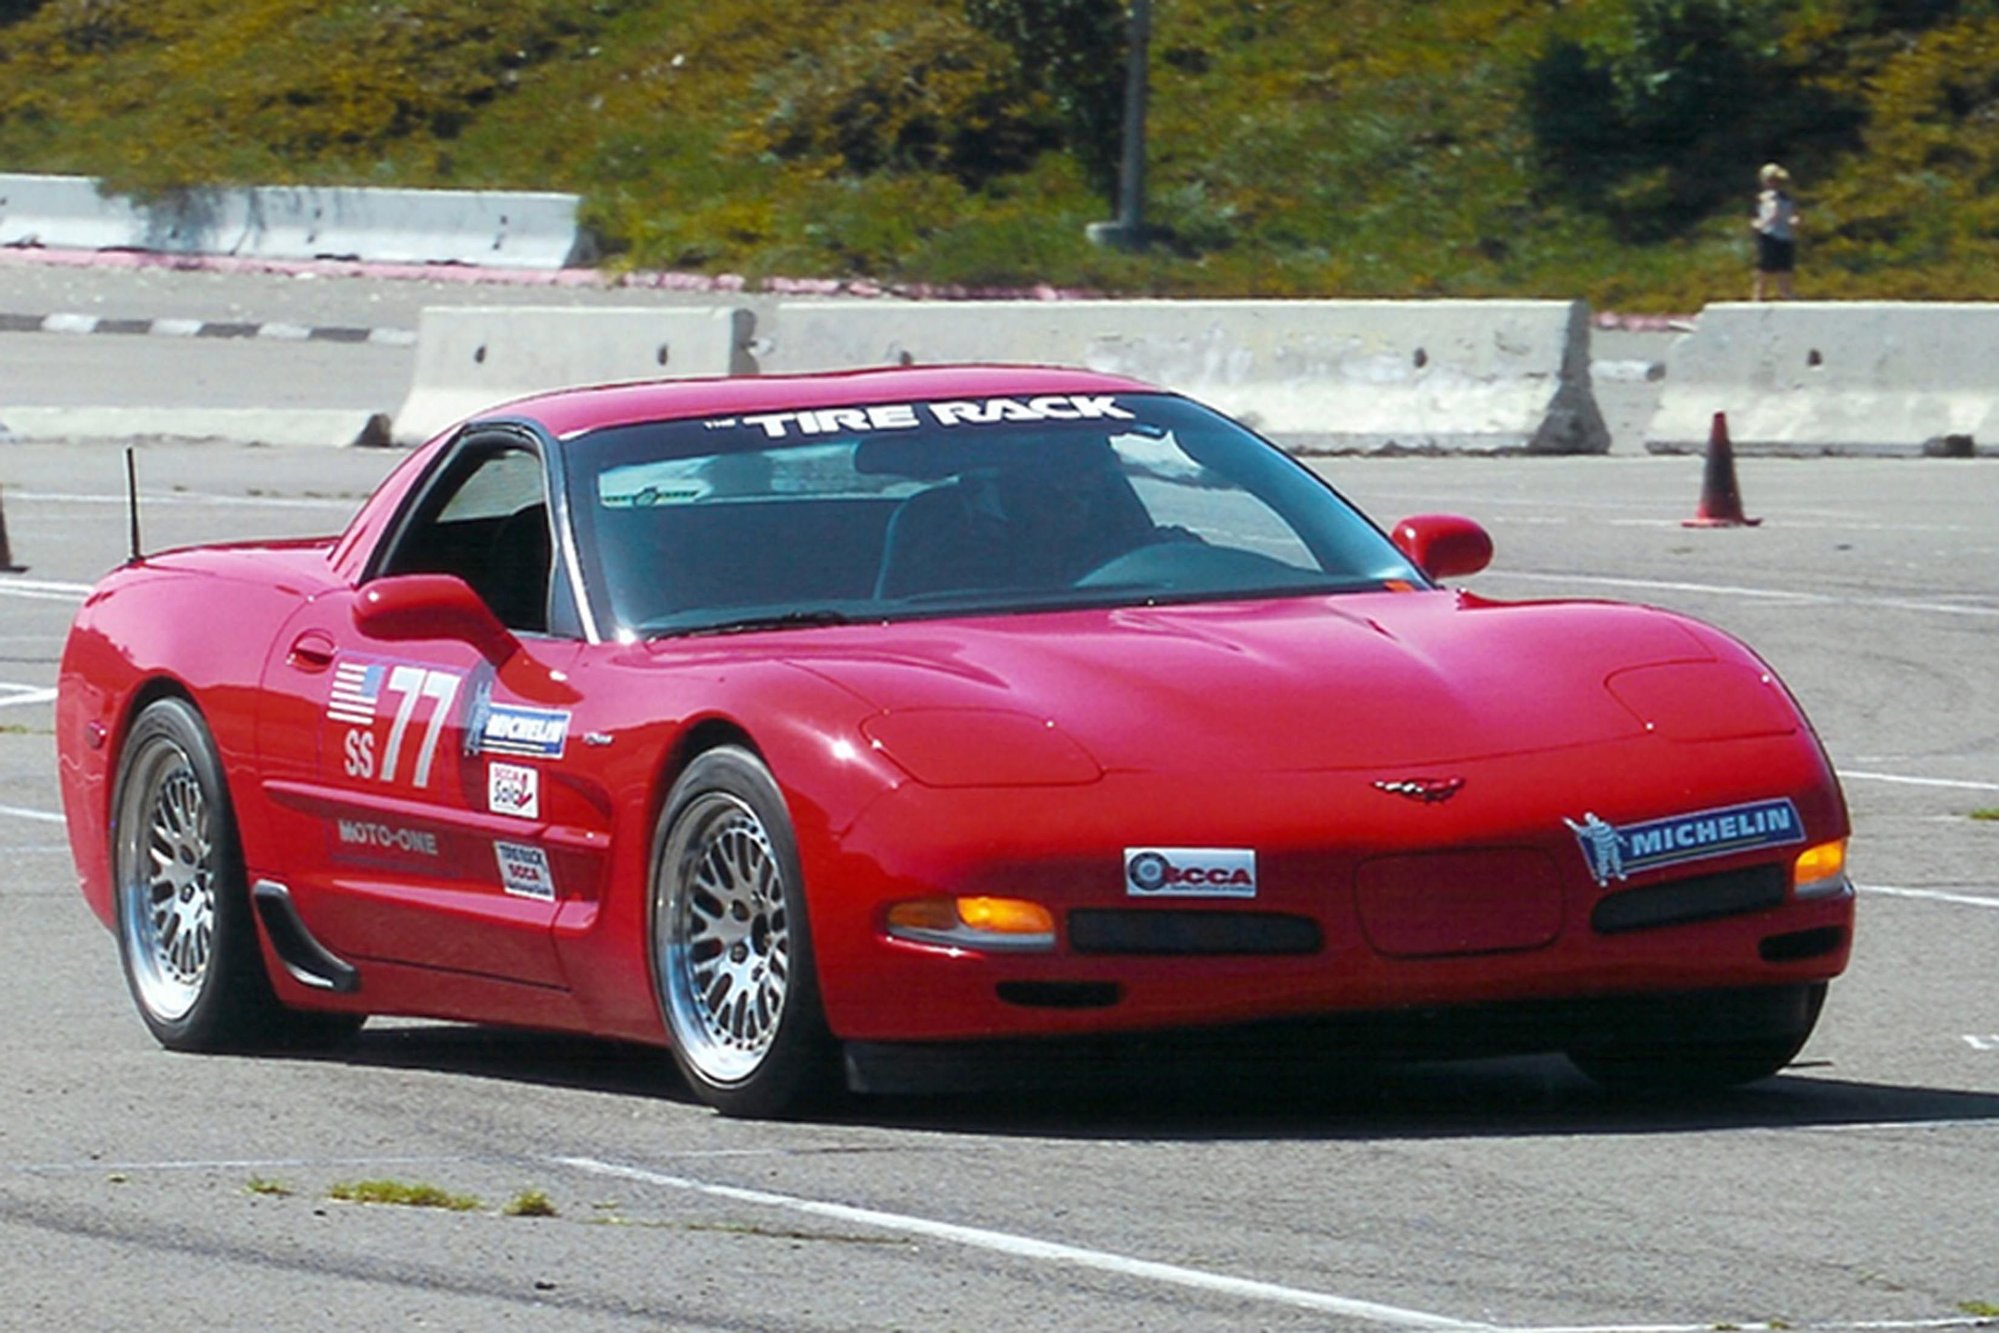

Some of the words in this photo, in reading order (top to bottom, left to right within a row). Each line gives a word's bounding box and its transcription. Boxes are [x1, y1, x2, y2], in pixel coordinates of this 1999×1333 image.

[743, 404, 920, 438] TIRE
[928, 396, 1136, 426] RACK
[380, 666, 461, 787] 77
[344, 728, 375, 779] SS
[338, 819, 439, 856] MOTO-ONE
[1631, 807, 1792, 857] MICHELIN
[1162, 866, 1253, 886] SCCA
